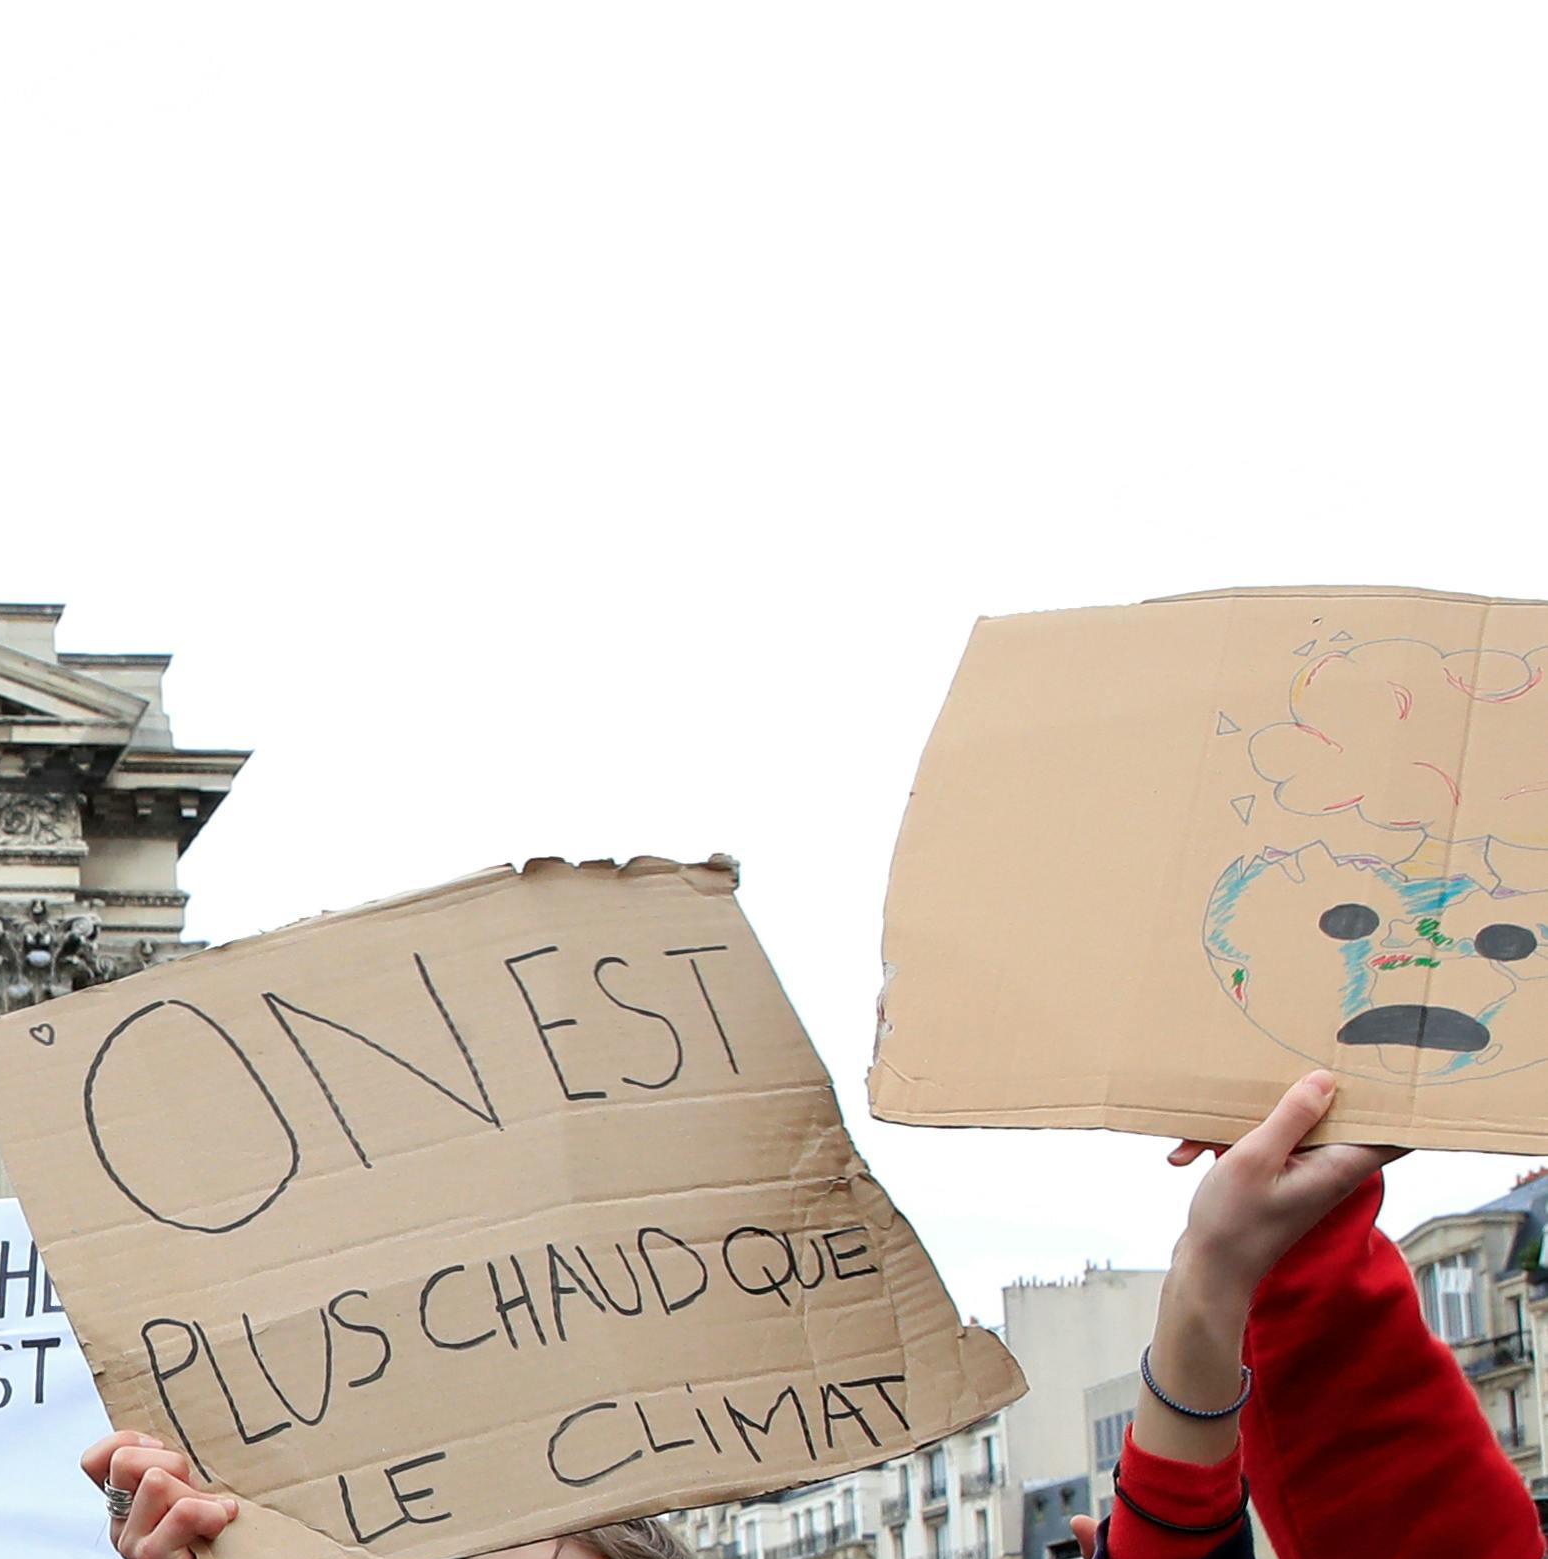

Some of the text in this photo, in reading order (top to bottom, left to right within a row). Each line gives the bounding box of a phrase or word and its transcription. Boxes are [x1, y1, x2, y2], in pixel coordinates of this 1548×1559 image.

[83, 944, 741, 1235] ON EST
[141, 1226, 881, 1485] PLUS CHAUD QUE
[338, 1453, 453, 1546] LE
